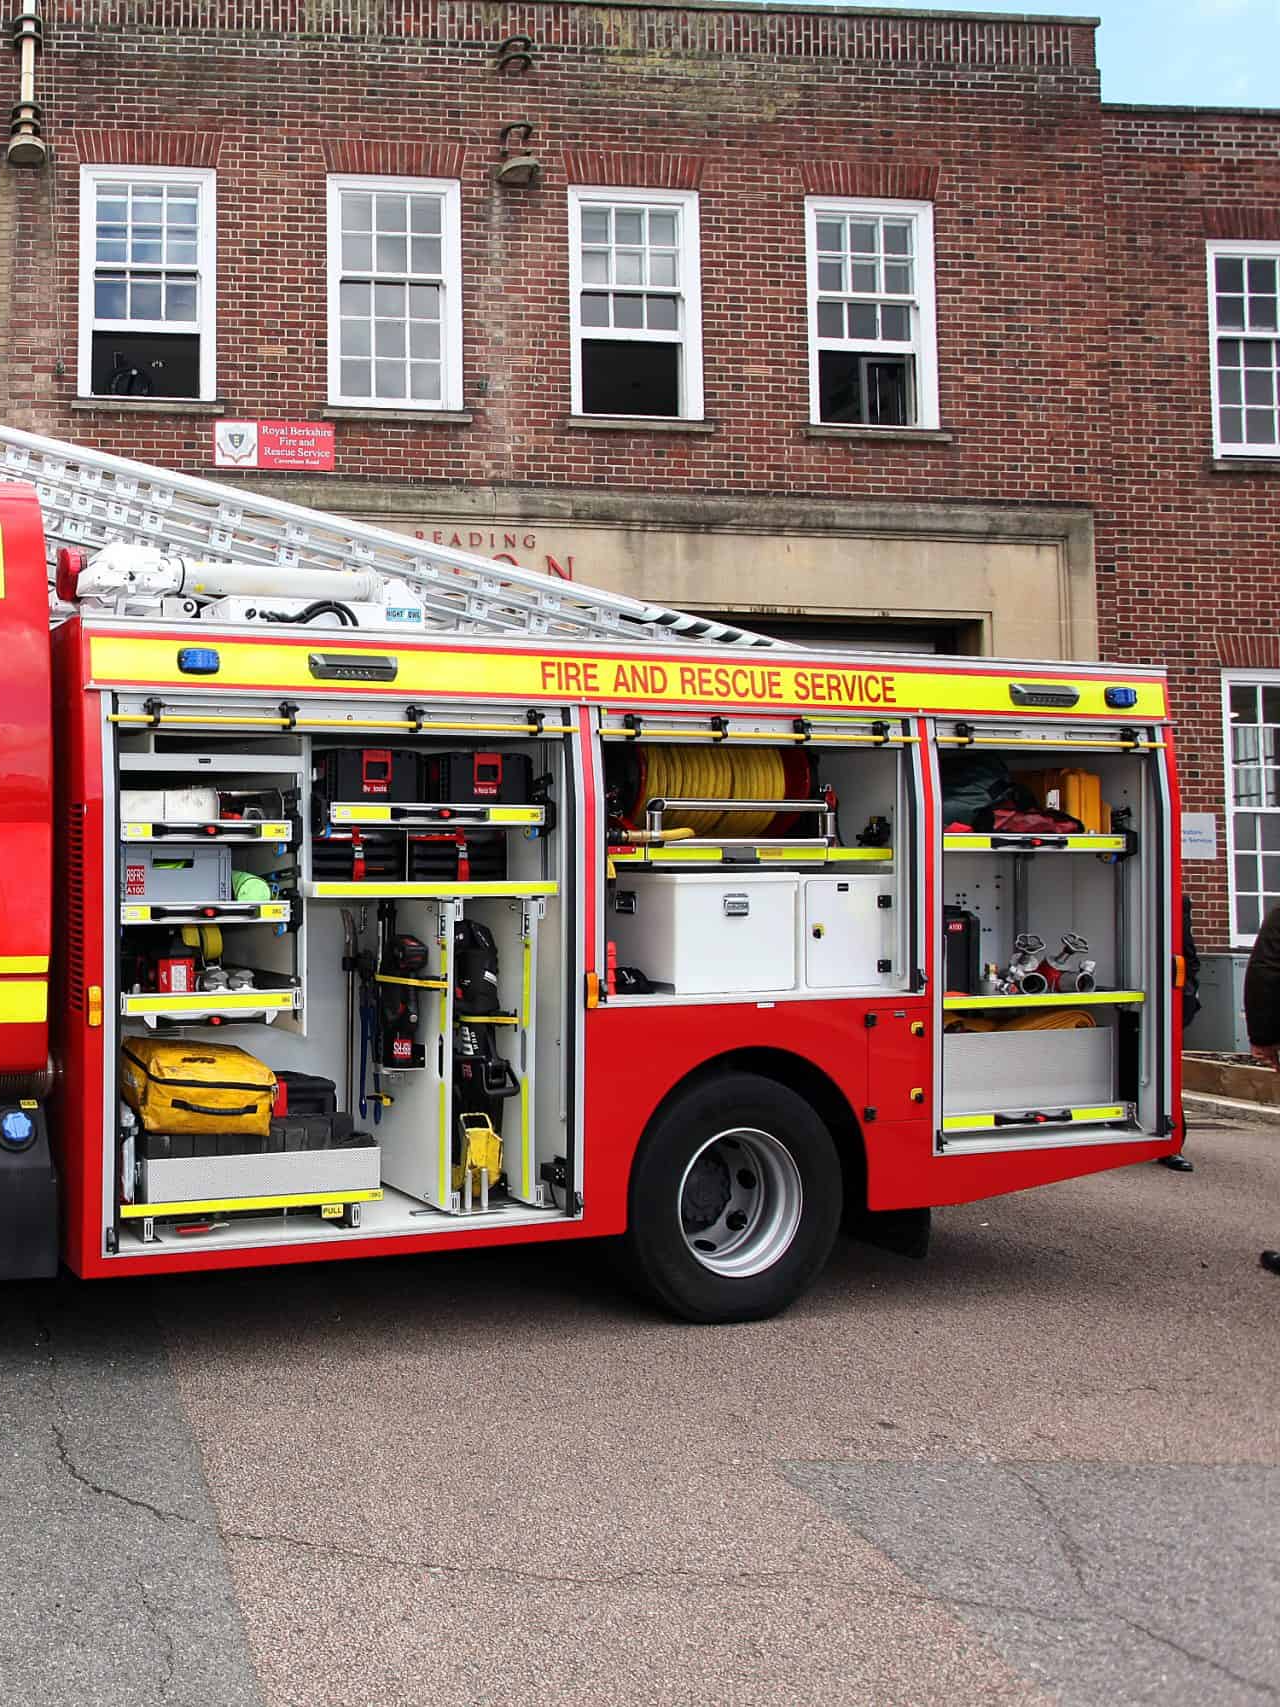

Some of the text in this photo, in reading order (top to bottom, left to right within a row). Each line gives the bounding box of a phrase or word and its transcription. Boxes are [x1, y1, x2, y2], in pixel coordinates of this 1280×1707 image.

[262, 426, 333, 437] Royal Berkshire
[279, 437, 315, 447] Fire and
[264, 447, 331, 458] Rescue Service
[415, 530, 536, 549] READING
[541, 661, 897, 703] FIRE AND RESCUE SERVICE
